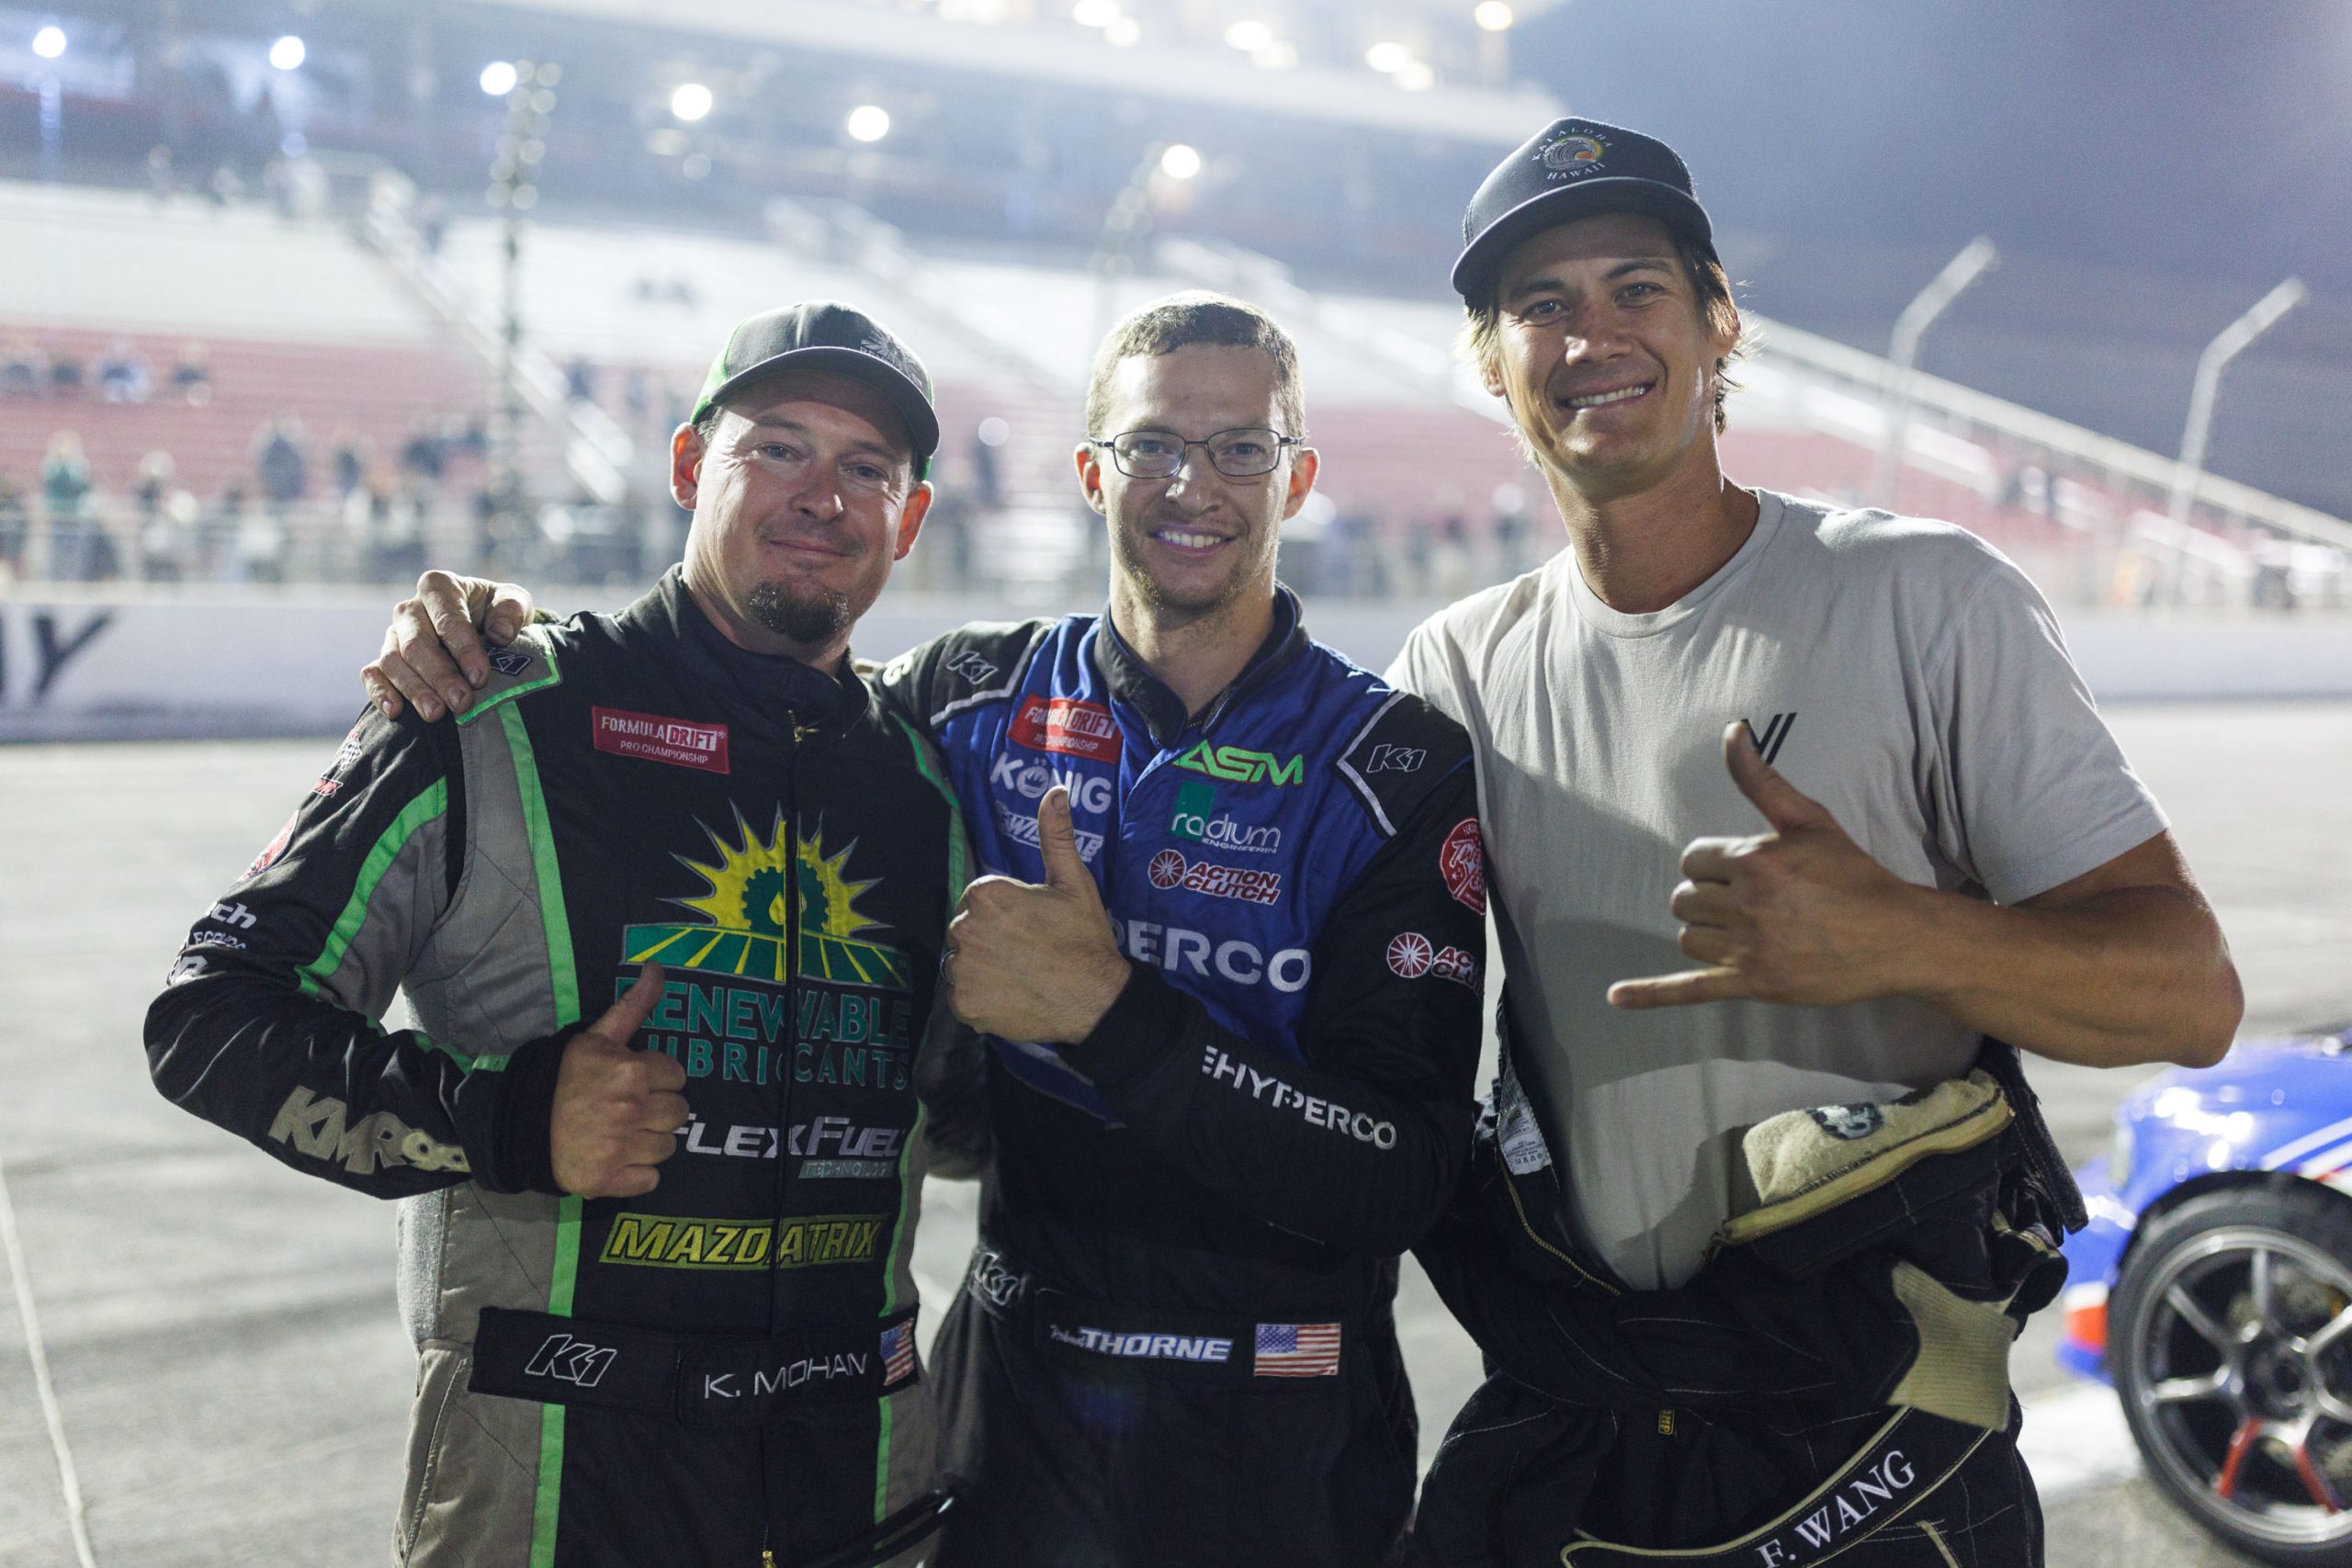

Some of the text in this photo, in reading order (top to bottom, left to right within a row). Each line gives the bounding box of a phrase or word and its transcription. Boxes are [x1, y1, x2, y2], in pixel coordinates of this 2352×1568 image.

[1546, 162, 1606, 180] HAWAII
[601, 716, 717, 751] FORMULA DRIFT
[620, 740, 708, 764] PRO CHAMPIONSHIP
[1171, 739, 1303, 786] ASM
[1366, 744, 1427, 773] K1
[1171, 813, 1282, 848] radium
[1182, 874, 1282, 906] CLUTCH
[1187, 862, 1282, 889] ACTION
[1108, 913, 1311, 992] ERCO
[606, 1218, 882, 1264] MAZDATRIX
[525, 1334, 617, 1387] K1
[1080, 1327, 1233, 1361] THORNE
[705, 1353, 867, 1399] K. MOHAN
[1755, 1450, 1916, 1568] F. WANG
